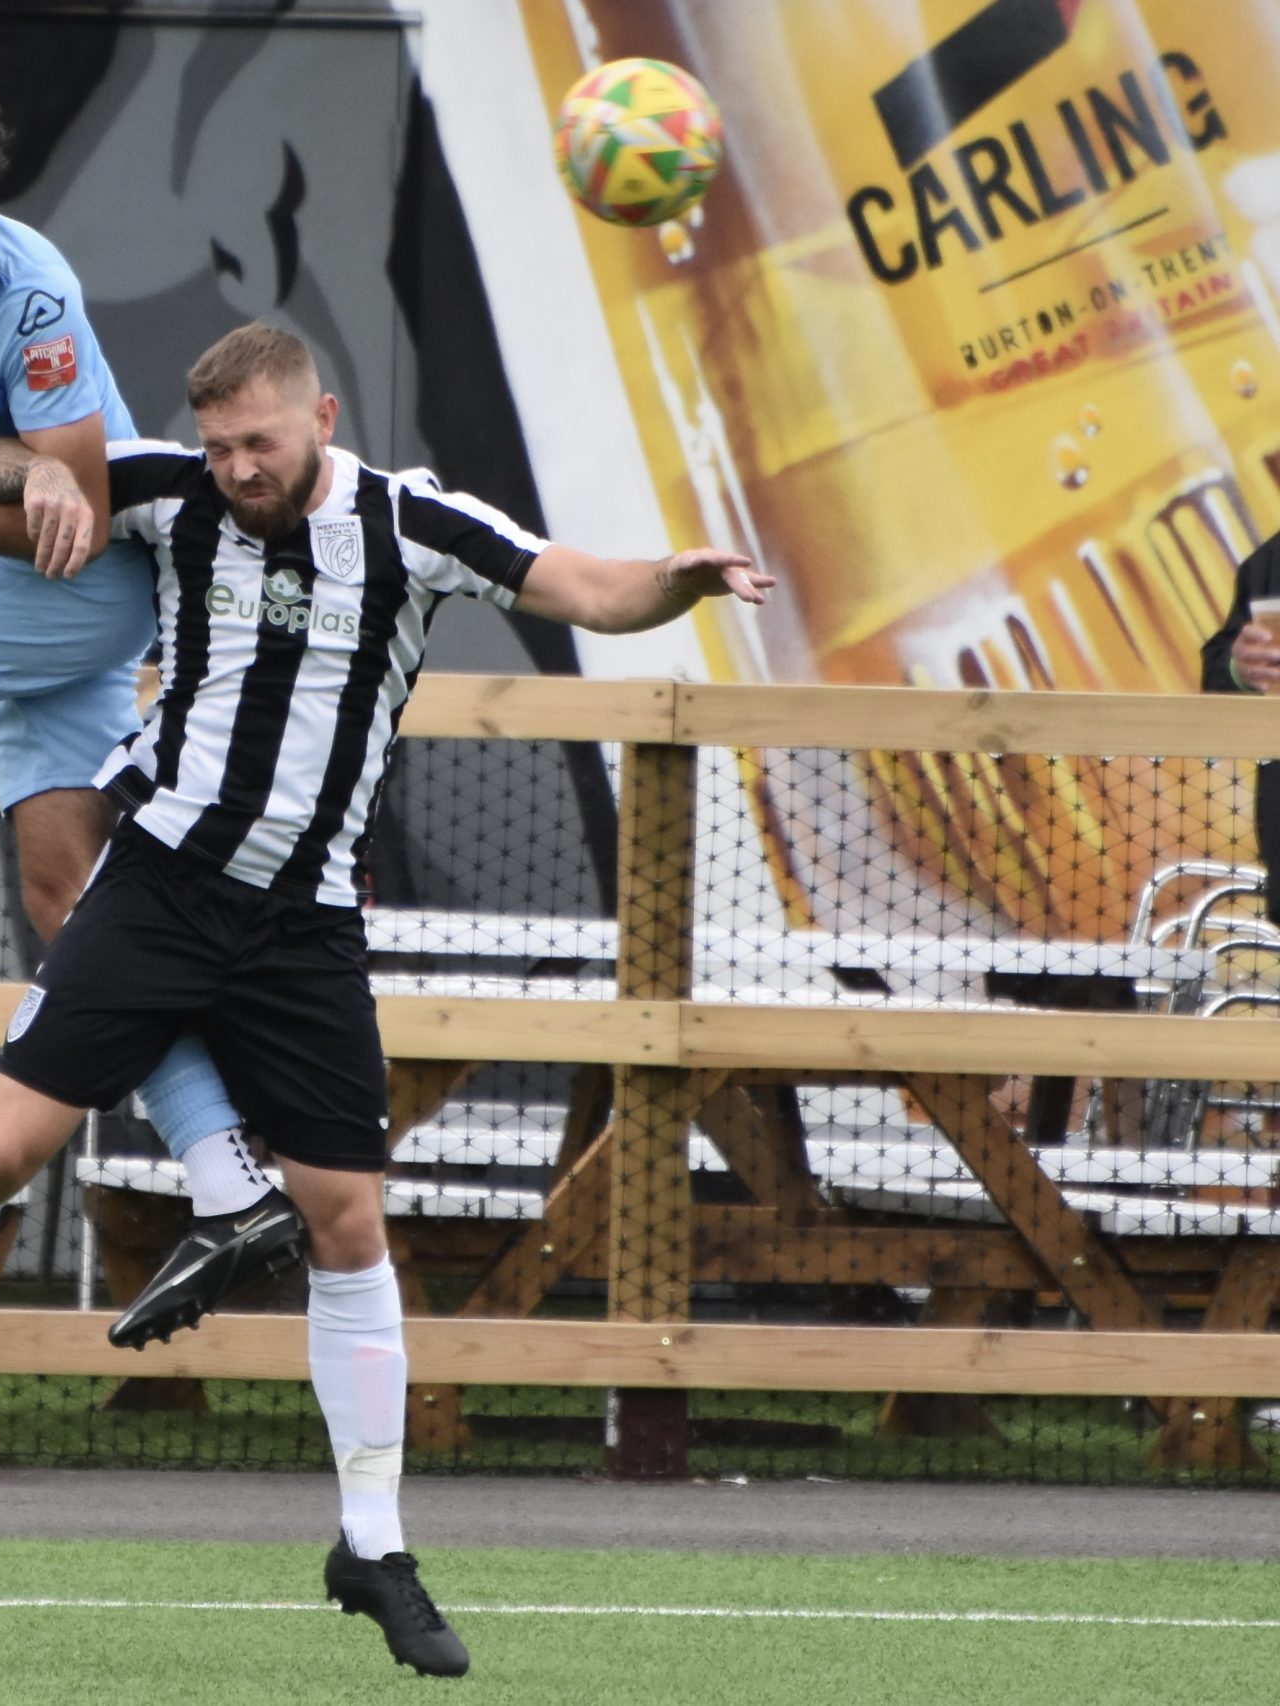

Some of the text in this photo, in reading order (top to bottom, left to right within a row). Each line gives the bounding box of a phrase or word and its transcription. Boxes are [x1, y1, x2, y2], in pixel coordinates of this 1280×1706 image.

[846, 51, 1228, 285] CARLING
[29, 340, 68, 361] PITCHING
[316, 521, 356, 531] MERTHYR
[205, 584, 357, 634] europlas
